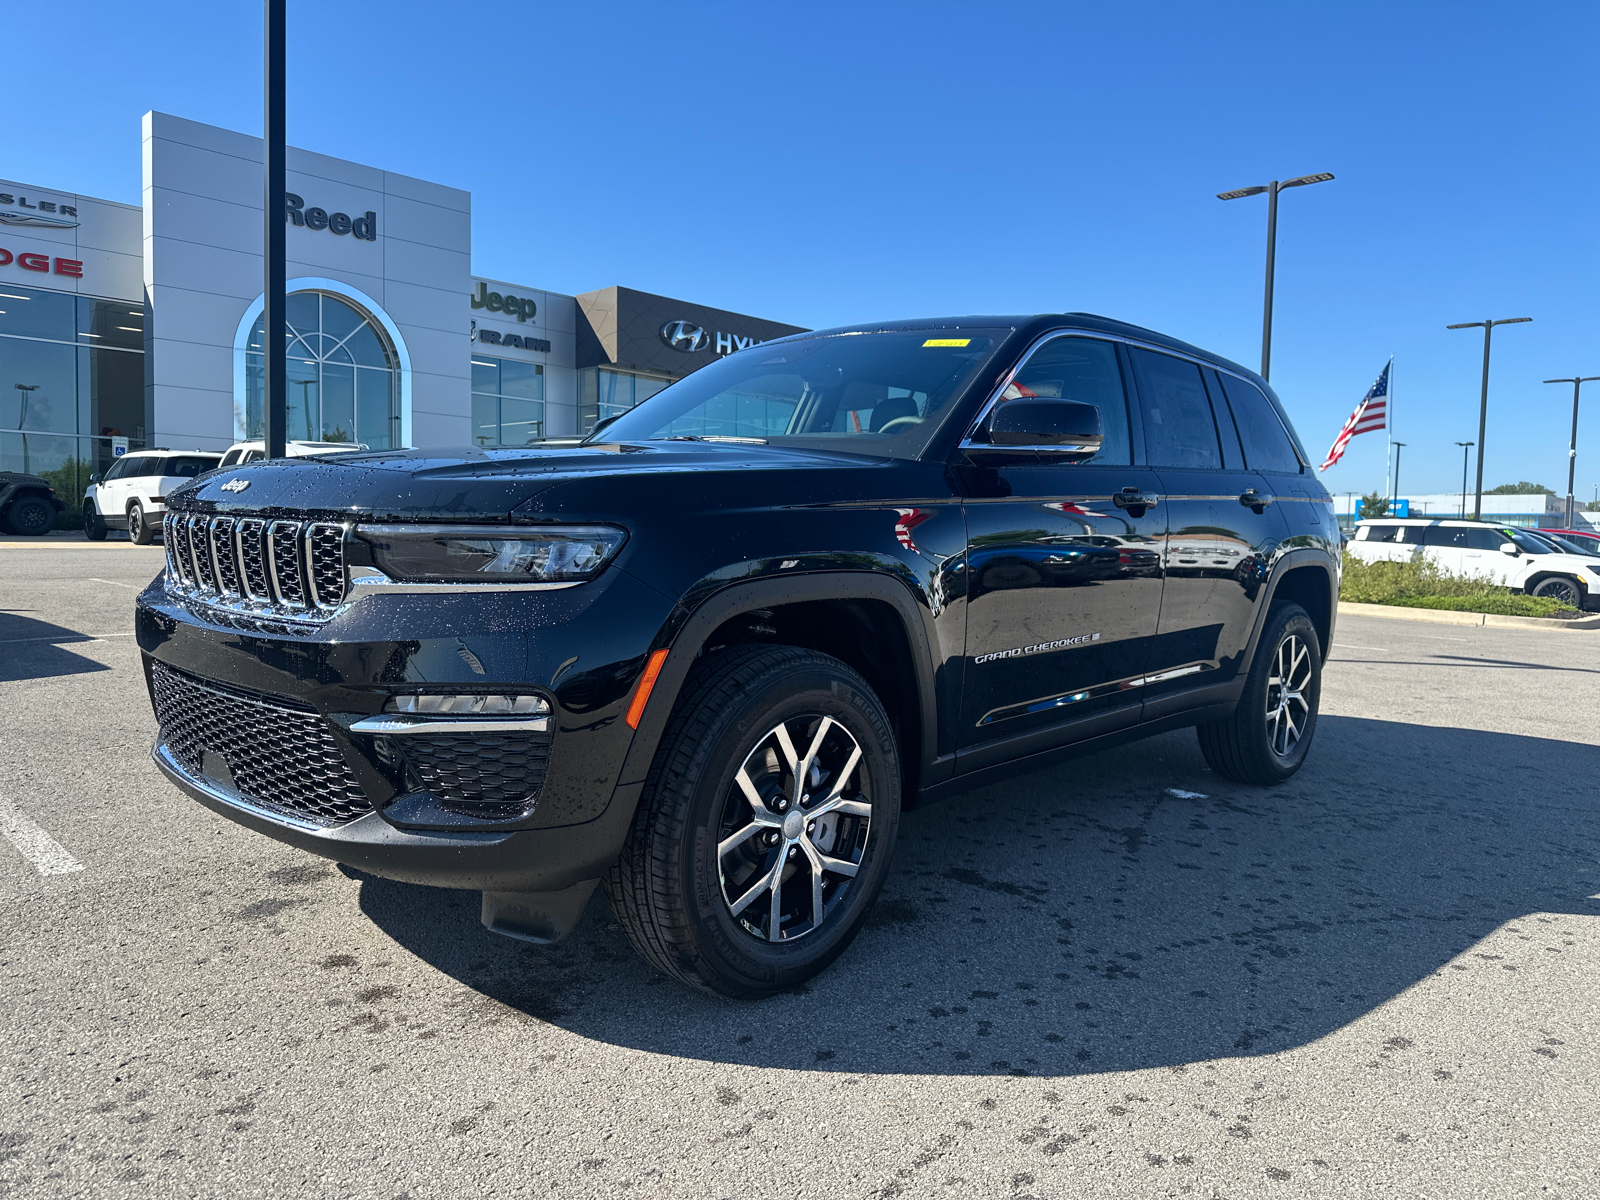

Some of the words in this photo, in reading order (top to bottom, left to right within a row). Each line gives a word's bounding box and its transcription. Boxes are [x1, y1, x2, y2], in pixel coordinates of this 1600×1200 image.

[286, 192, 376, 241] Reed
[471, 282, 537, 323] Jeep
[479, 330, 551, 353] RAM
[221, 478, 251, 494] Jeep
[974, 648, 1021, 664] GRAND
[1024, 635, 1090, 654] CHEROKEE
[852, 695, 892, 754] MICHELIN
[695, 856, 707, 908] PRIMACY
